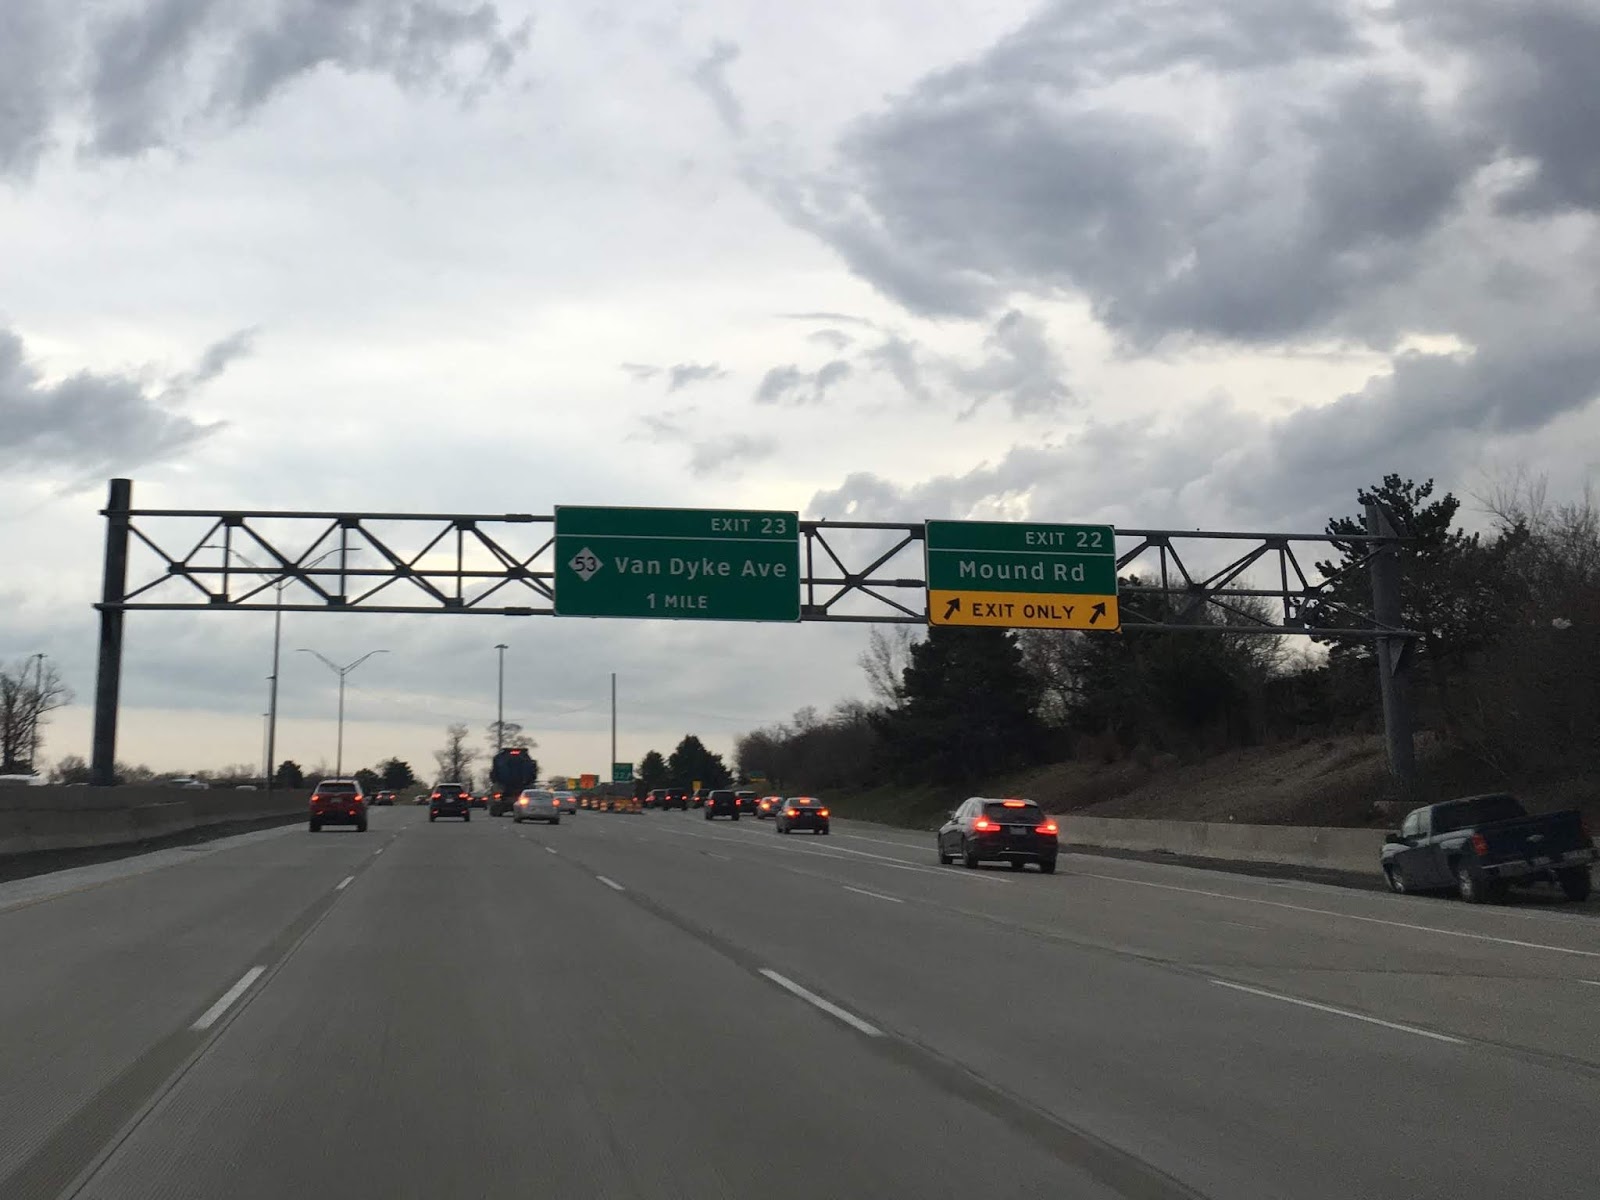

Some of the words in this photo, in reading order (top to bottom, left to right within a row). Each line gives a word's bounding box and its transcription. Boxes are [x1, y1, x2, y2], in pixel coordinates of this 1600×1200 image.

[711, 518, 751, 532] EXIT
[760, 518, 787, 534] 23
[1025, 531, 1065, 545] EXIT
[1076, 532, 1102, 548] 22
[574, 556, 597, 572] 53
[614, 556, 661, 575] Van
[670, 557, 730, 580] Dyke
[741, 560, 787, 578] Ave
[958, 560, 1045, 580] Mound
[1054, 563, 1085, 582] Rd
[646, 593, 656, 608] 1
[664, 595, 708, 608] MILE
[972, 602, 1015, 618] EXIT
[1023, 604, 1075, 619] ONLY
